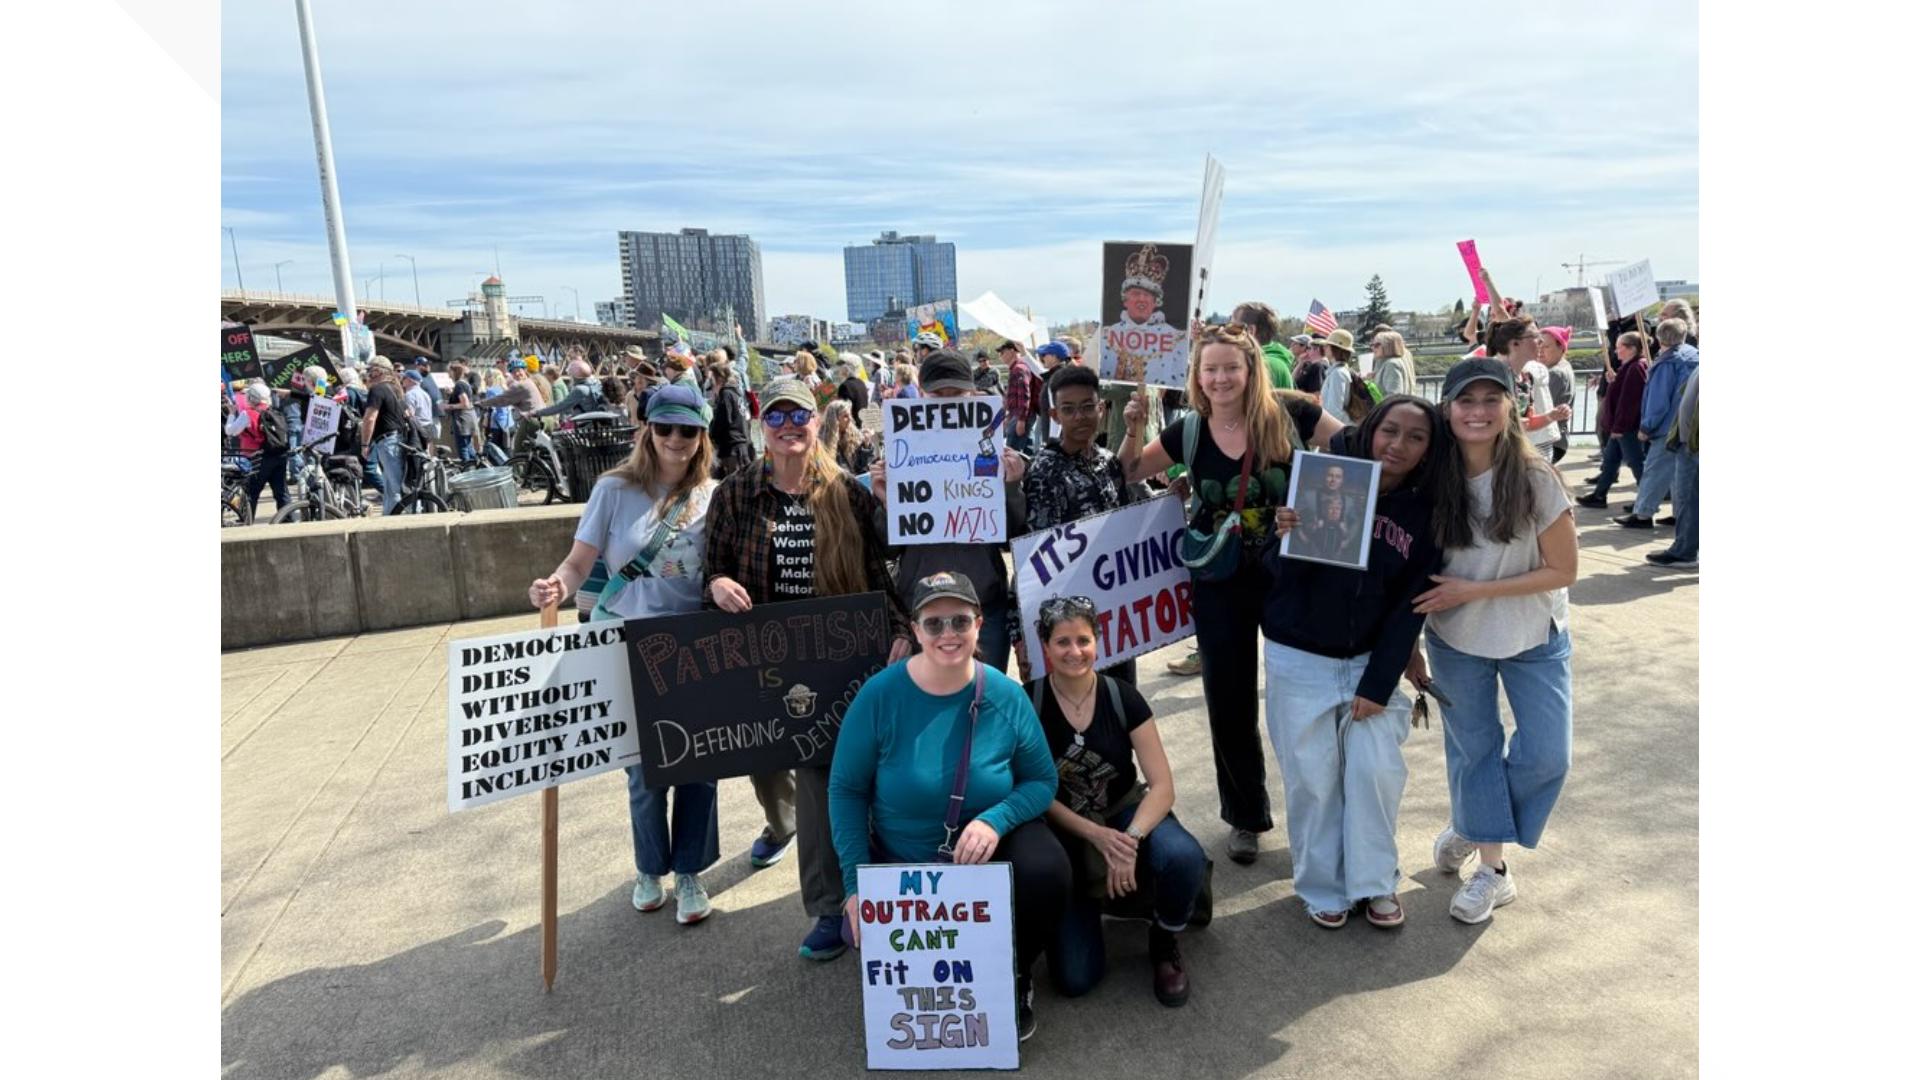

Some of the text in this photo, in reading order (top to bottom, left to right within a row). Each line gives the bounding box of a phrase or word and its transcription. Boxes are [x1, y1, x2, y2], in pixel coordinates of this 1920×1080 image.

[228, 333, 249, 345] OFF
[1109, 330, 1174, 352] NOPE
[271, 357, 302, 388] HANDS
[891, 401, 993, 433] DEFEND
[898, 479, 993, 503] NO KINGS
[899, 505, 998, 542] NO NAZIS
[776, 553, 814, 565] Rarel
[1029, 523, 1088, 587] IT'S
[775, 582, 814, 594] Histor
[461, 626, 627, 667] DEMOCRACY
[637, 607, 890, 696] PATRIOTISM
[462, 666, 531, 694] DIES
[758, 667, 783, 688] IS
[461, 679, 597, 719] WITHOUT
[462, 700, 612, 747] DIVERSITY
[462, 721, 627, 773] EQUITY AND
[653, 719, 785, 769] DEFENDING
[462, 747, 612, 800] INCLUSION
[900, 870, 943, 895] MY
[861, 900, 991, 924] OUTRAGE
[889, 926, 959, 952] CAN'T
[933, 960, 973, 983] ON
[897, 986, 976, 1011] THIS
[886, 1012, 990, 1051] SIGN
